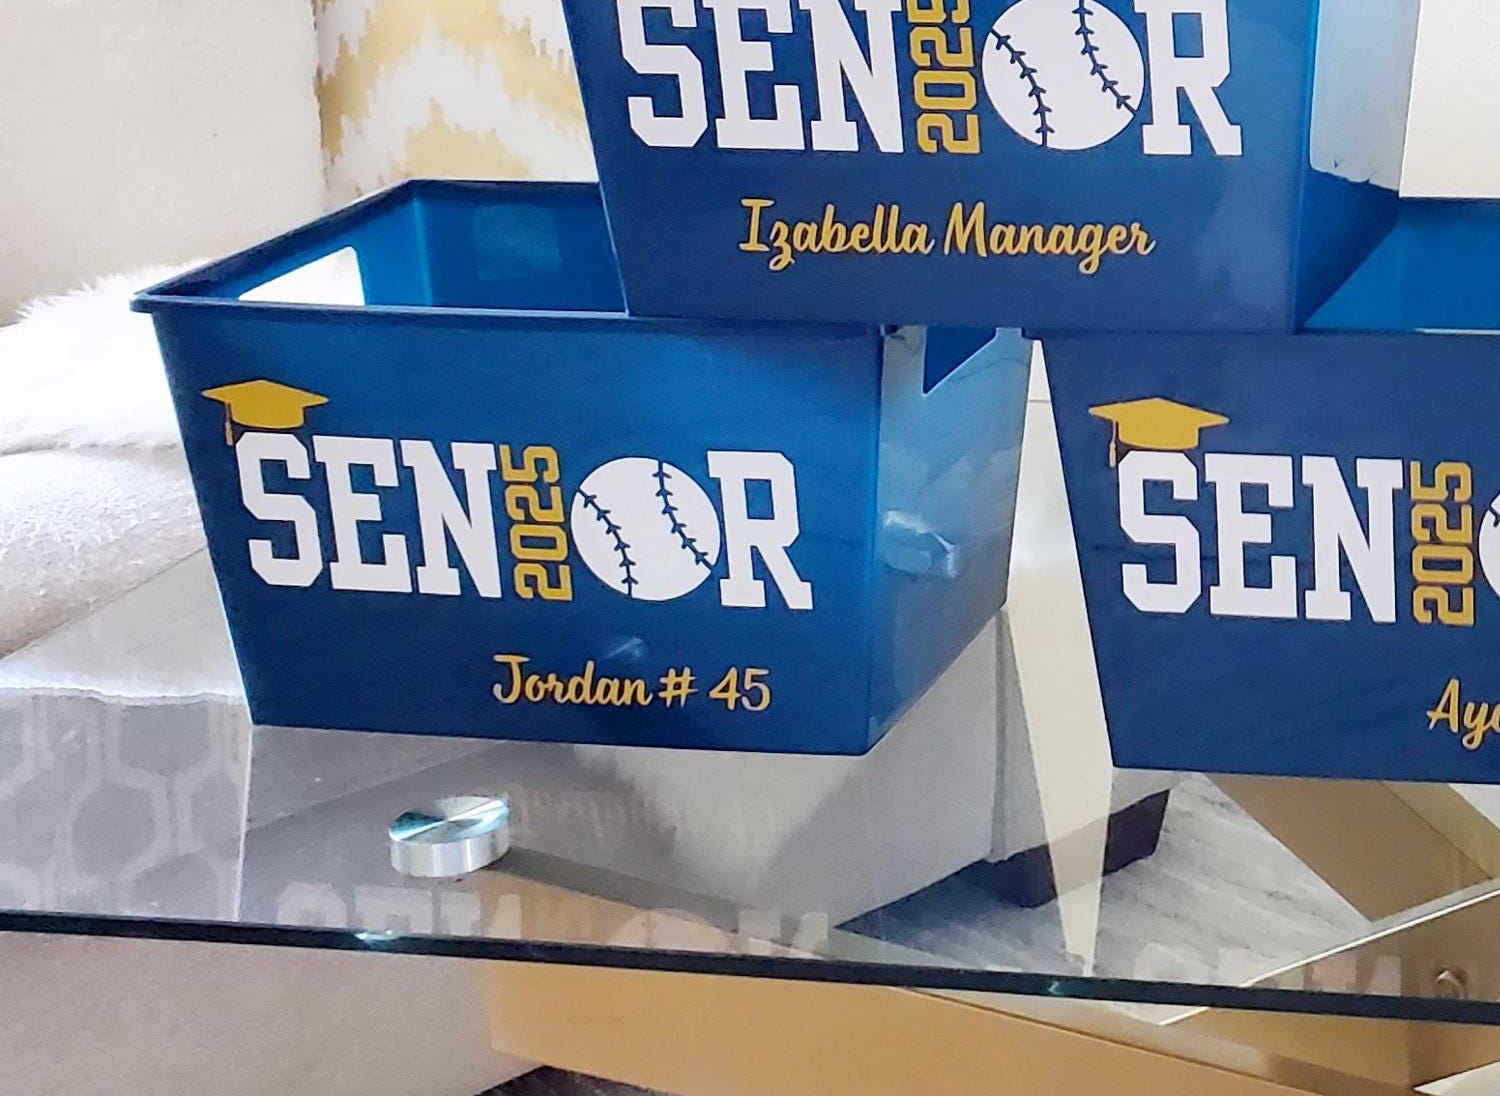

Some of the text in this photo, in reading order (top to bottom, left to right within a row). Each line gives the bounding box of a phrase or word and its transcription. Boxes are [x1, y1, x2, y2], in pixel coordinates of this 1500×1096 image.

[738, 198, 1157, 275] Izabella Manager
[500, 444, 572, 602] 2025
[1410, 460, 1476, 626] 2025
[492, 653, 771, 712] Jordan # 45
